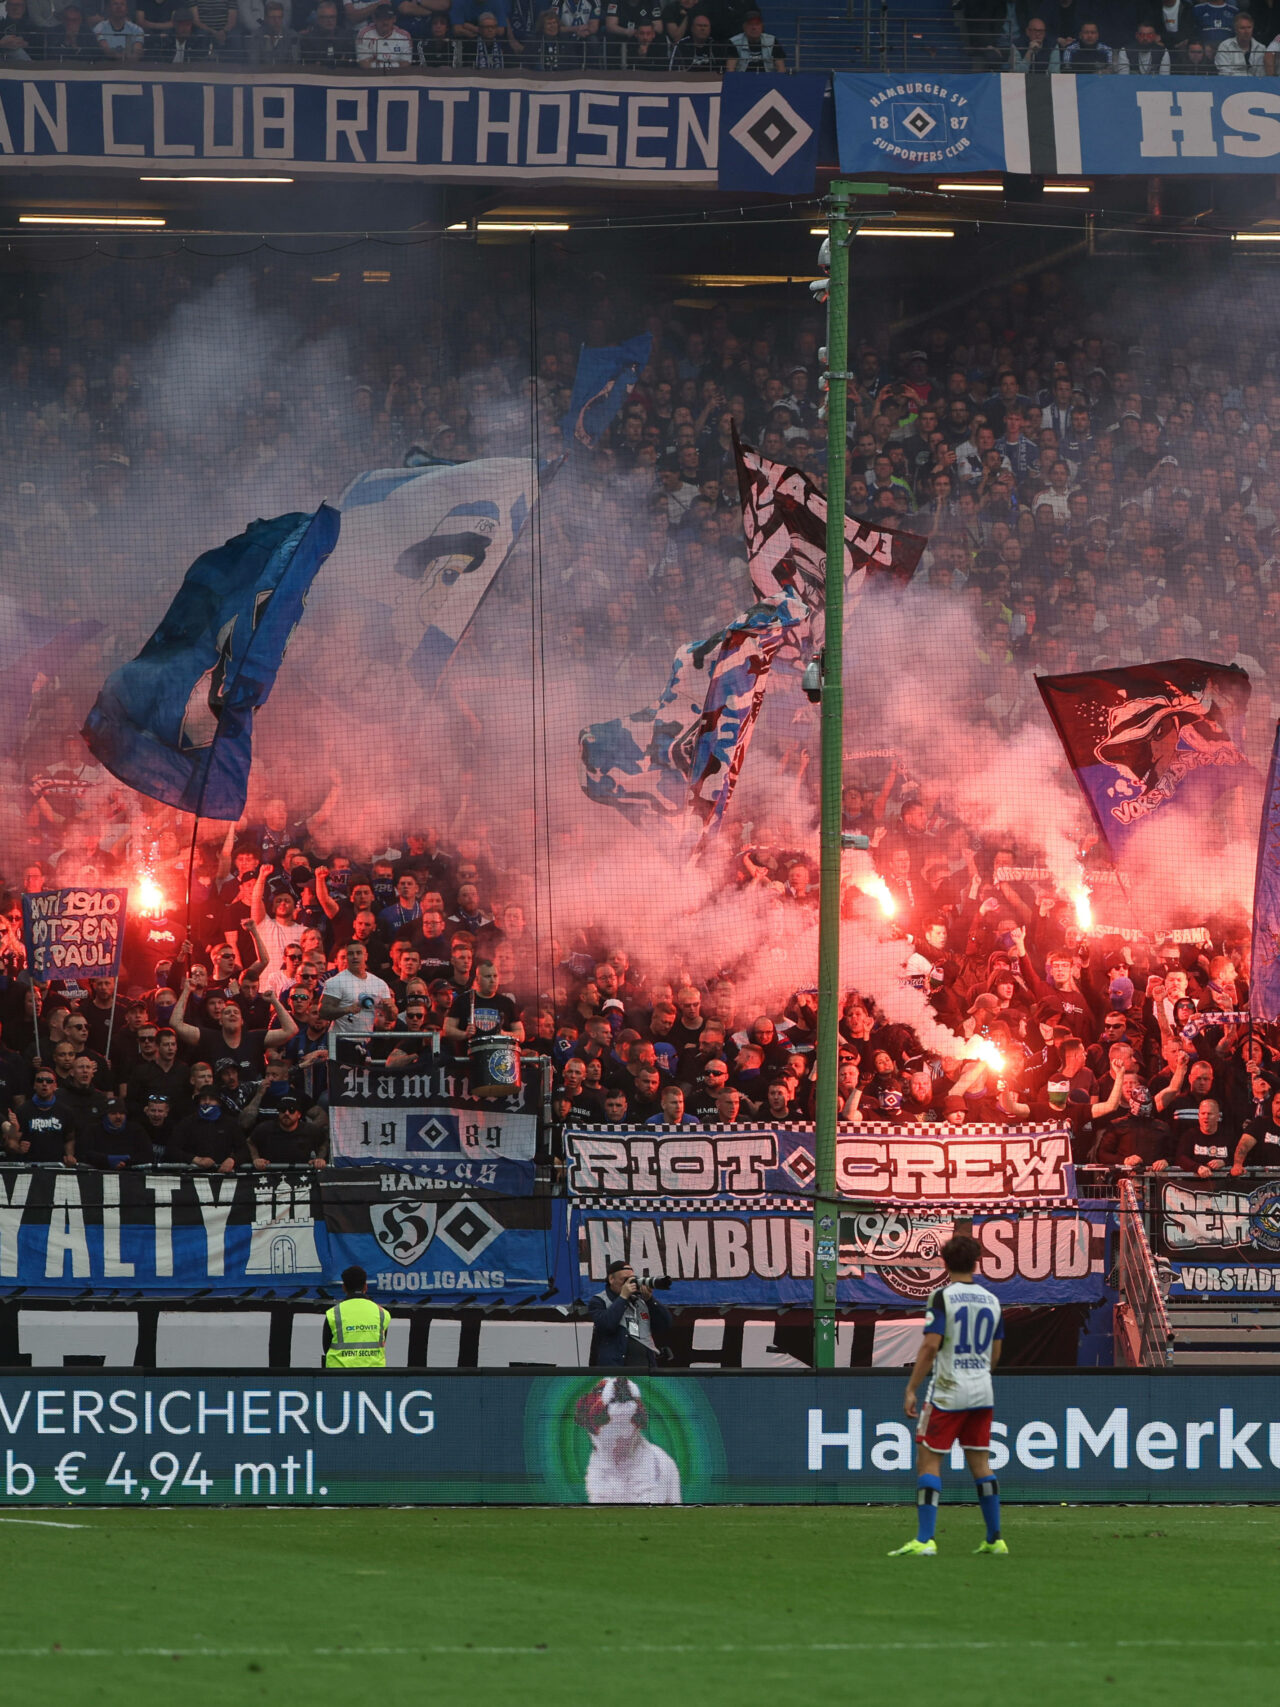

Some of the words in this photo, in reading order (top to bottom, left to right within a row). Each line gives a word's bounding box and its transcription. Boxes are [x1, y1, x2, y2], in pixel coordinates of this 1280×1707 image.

[869, 83, 948, 108] HAMBURGER
[950, 93, 968, 108] SV
[0, 82, 69, 154] N
[102, 83, 295, 159] CLUB
[326, 88, 720, 170] ROTHOSEN
[870, 116, 889, 130] 18
[950, 116, 969, 130] 87
[872, 137, 944, 163] SUPPORTERS
[946, 137, 971, 158] CLUB
[62, 891, 121, 917] 1910
[339, 1064, 528, 1113] Hambug
[360, 1120, 398, 1146] 19
[465, 1123, 503, 1149] 89
[574, 1134, 776, 1194] RIOT
[838, 1136, 1068, 1199] CREW
[0, 1173, 238, 1278] YALTY
[857, 1212, 909, 1255] 96
[376, 1270, 505, 1291] HOOLIGANS
[954, 1305, 995, 1356] 10
[341, 1350, 358, 1358] EVENT
[0, 1390, 436, 1435] VERSICHERUNG
[54, 1451, 87, 1495] €
[105, 1451, 214, 1501] 4,94
[233, 1449, 328, 1496] mtl.
